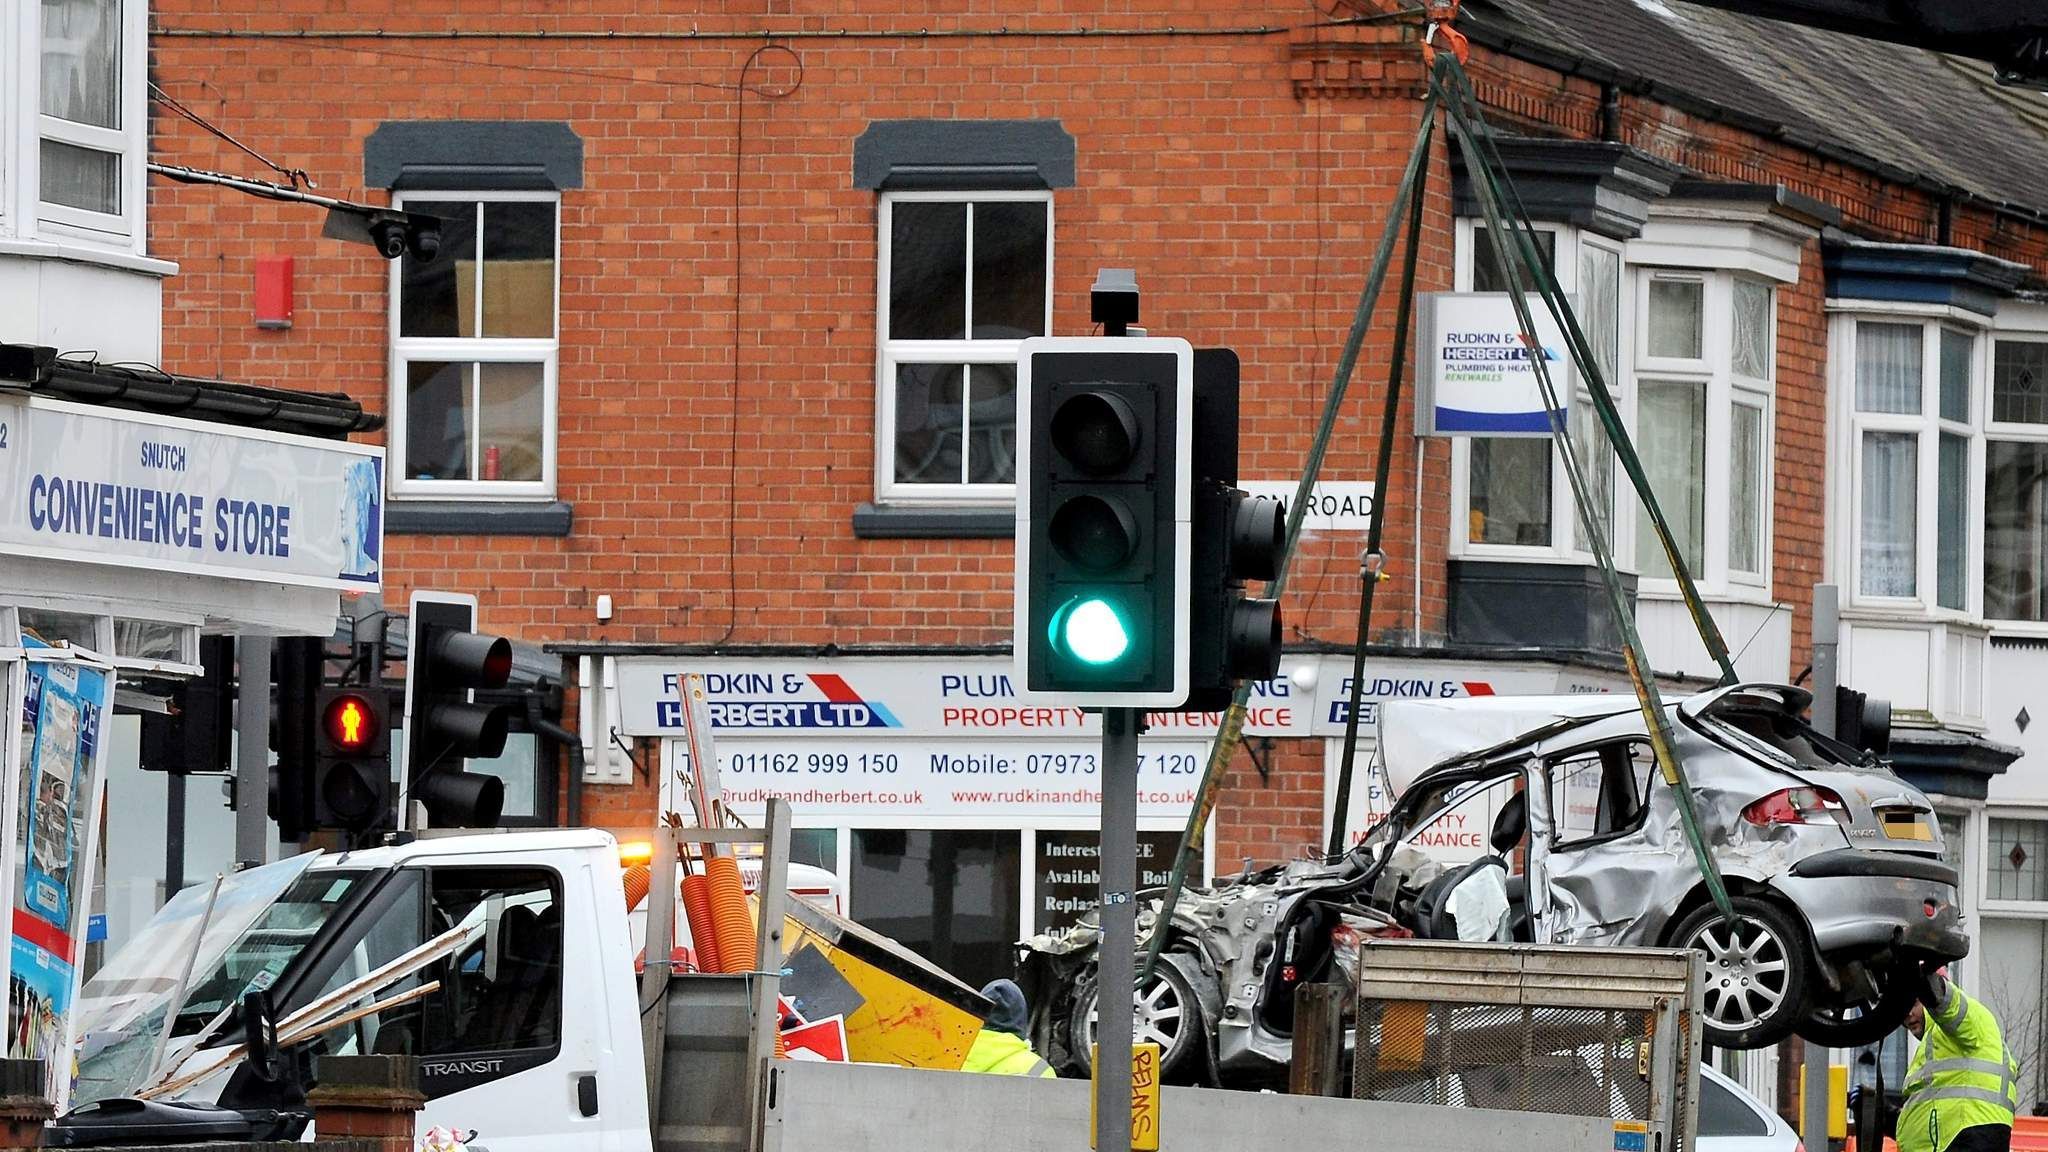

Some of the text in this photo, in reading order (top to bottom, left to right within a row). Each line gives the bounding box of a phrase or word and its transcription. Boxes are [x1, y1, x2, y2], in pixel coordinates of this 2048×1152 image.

[1447, 333, 1515, 344] RUDKIN &
[1445, 348, 1513, 360] HERBERT
[1445, 364, 1497, 372] PLUMBING
[1445, 373, 1503, 382] RENEWABLES
[140, 440, 186, 472] SNUTCH
[29, 473, 290, 558] CONVENIENCE STORE
[1303, 495, 1374, 517] ROAD
[662, 673, 804, 694] RDKIN &
[1439, 681, 1459, 698] &
[665, 703, 870, 726] HRBERT LTD
[943, 707, 1085, 727] PROPERTY
[731, 753, 799, 774] 01162
[807, 753, 849, 774] 999
[858, 753, 898, 774] 150
[930, 754, 1016, 774] Mobile:
[1026, 754, 1096, 774] 07973
[1156, 754, 1196, 774] 120
[1045, 869, 1101, 884] Availab
[423, 1059, 504, 1077] TRANSIT
